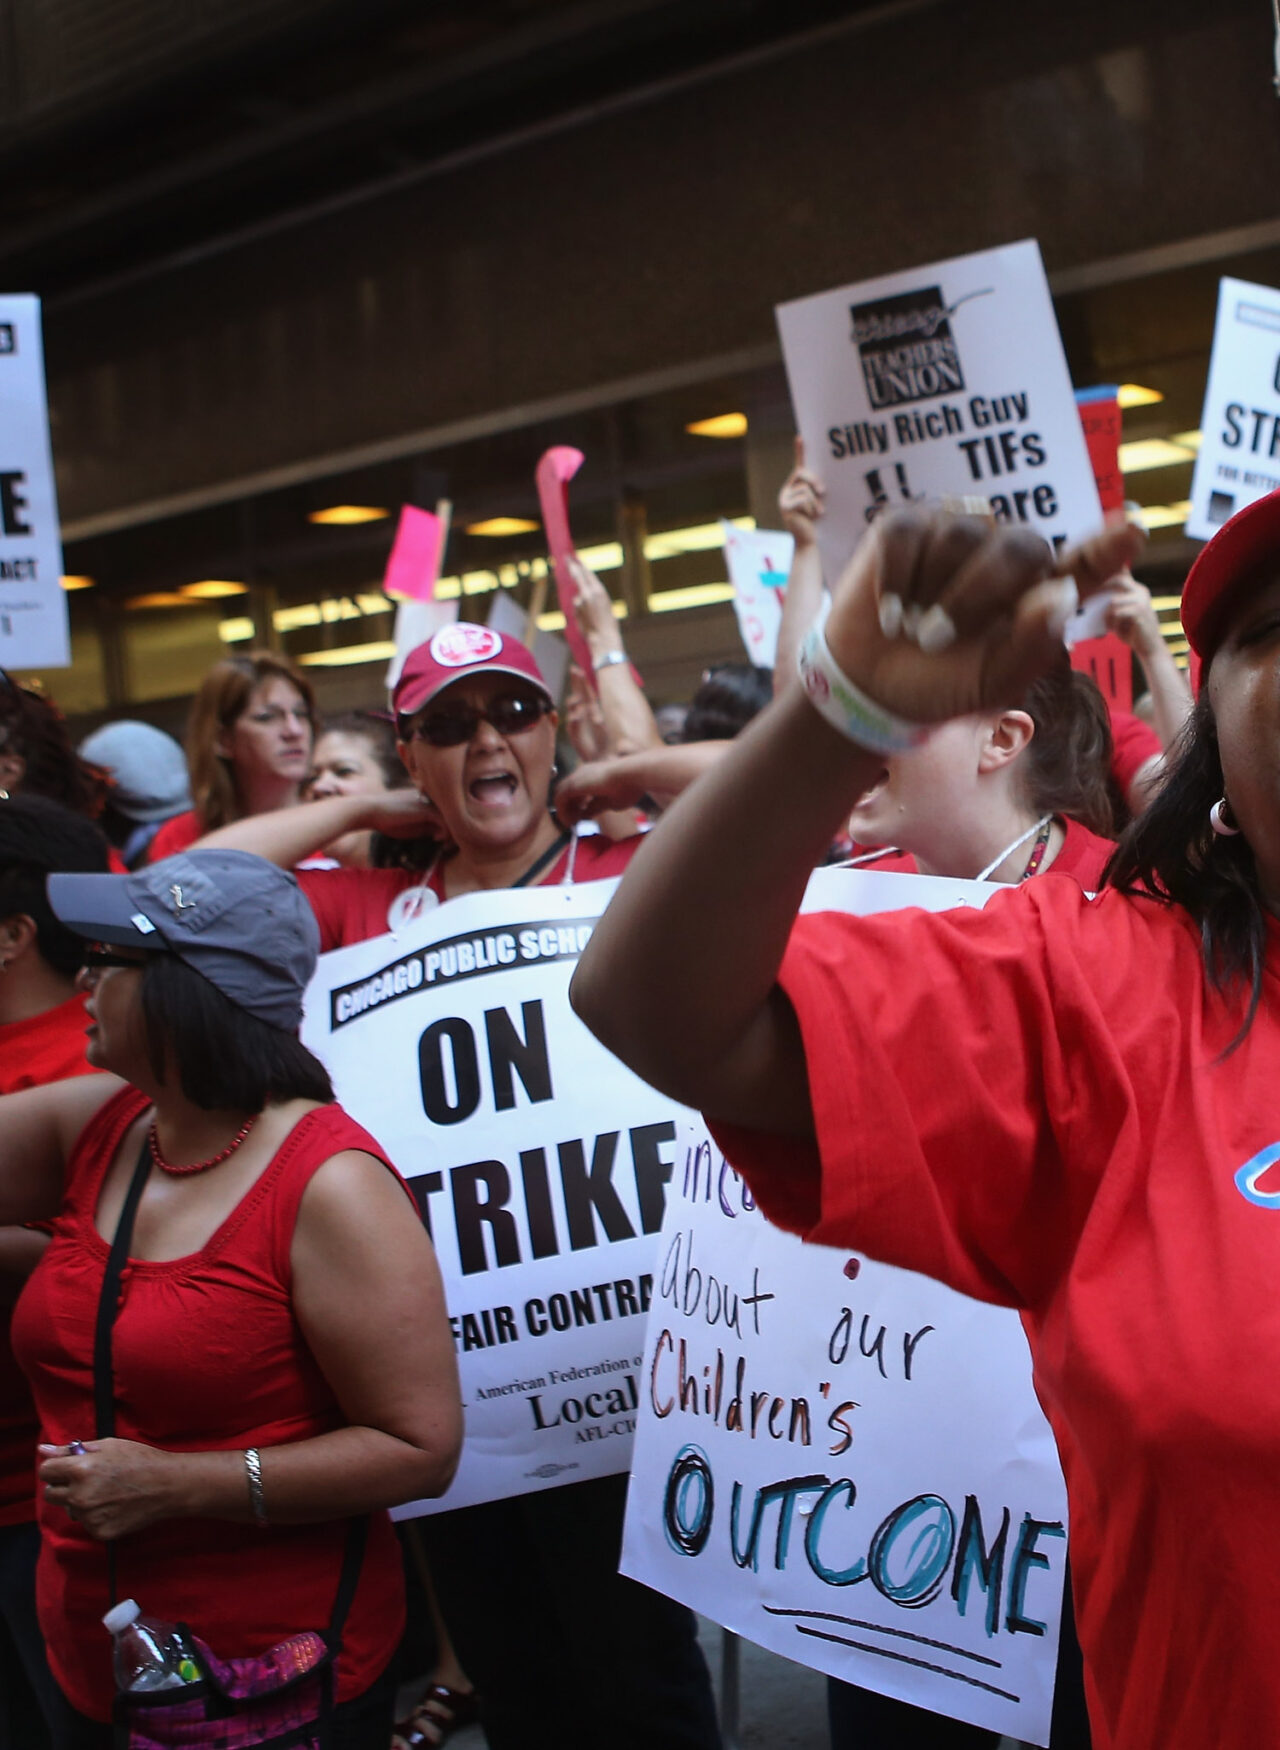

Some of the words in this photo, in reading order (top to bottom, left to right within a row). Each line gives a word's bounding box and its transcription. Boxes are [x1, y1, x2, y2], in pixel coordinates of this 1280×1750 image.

[862, 337, 954, 371] TEACHERS
[864, 359, 963, 408] UNION
[828, 422, 889, 459] Silly
[893, 404, 965, 446] Rich
[969, 391, 1029, 429] Guy
[958, 430, 1047, 481] TIFs
[989, 483, 1058, 523] are
[336, 958, 424, 1023] CHICAGO
[424, 933, 517, 982] PUBLIC
[519, 925, 595, 961] SCHO
[417, 999, 555, 1127] ON
[660, 1229, 776, 1339] about
[827, 1306, 937, 1382] our
[475, 1375, 547, 1402] American
[548, 1357, 632, 1387] Federation
[525, 1374, 640, 1432] Local
[650, 1328, 864, 1457] Children's
[663, 1443, 1068, 1639] OUTCOME
